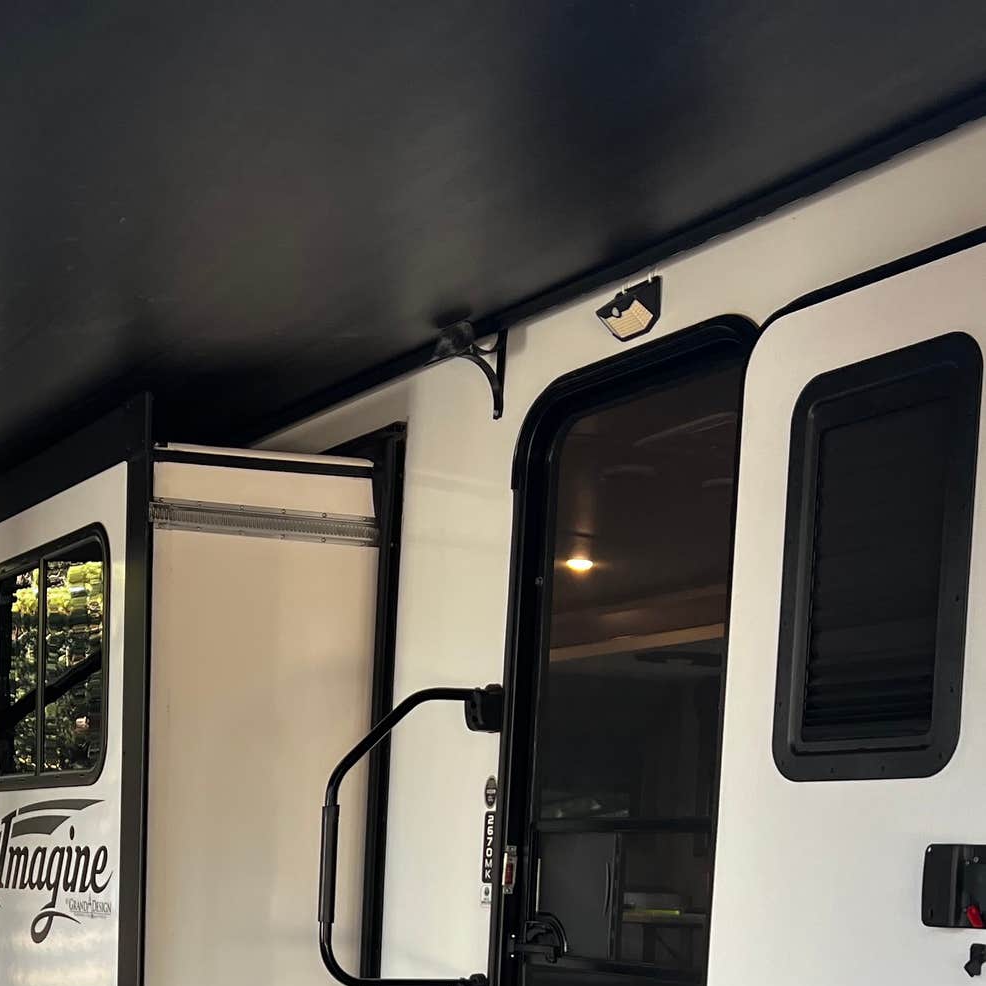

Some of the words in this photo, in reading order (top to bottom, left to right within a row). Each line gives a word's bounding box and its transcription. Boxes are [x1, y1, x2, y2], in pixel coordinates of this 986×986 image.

[484, 814, 494, 880] 2670MK
[69, 898, 88, 912] GRAND
[92, 900, 112, 913] DESIGN
